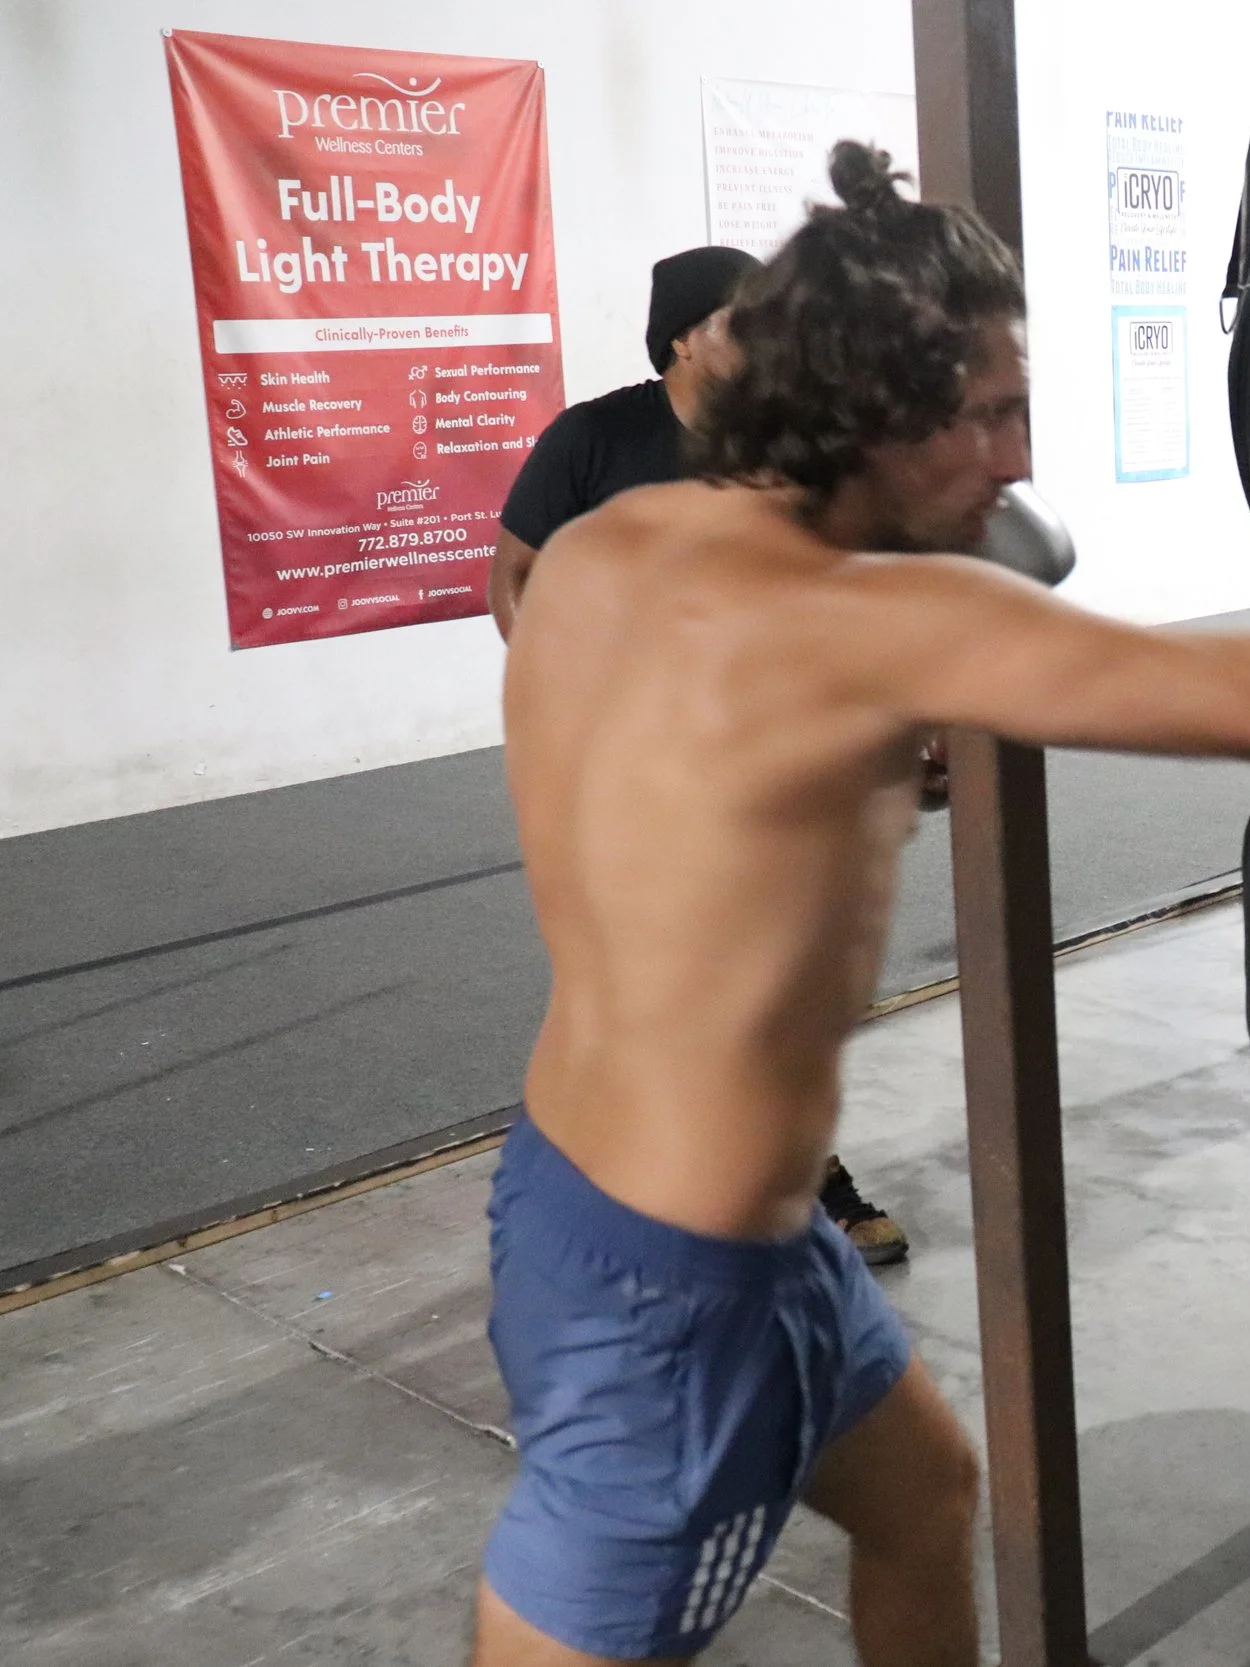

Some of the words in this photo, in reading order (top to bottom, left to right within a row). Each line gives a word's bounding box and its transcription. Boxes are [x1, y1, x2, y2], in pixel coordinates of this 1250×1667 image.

[272, 77, 466, 138] premier
[314, 136, 372, 154] Wellness
[375, 140, 423, 156] Centers
[1124, 173, 1173, 211] iCRYO
[278, 175, 480, 233] Full-Body
[236, 237, 348, 293] Light
[361, 237, 528, 291] Therapy
[1110, 244, 1141, 272] PAIN
[1145, 245, 1187, 273] RELIEF
[315, 327, 421, 343] Clinically-Proven
[425, 325, 469, 339] Benefits
[1134, 325, 1169, 350] iCRYO
[260, 372, 288, 386] Skin
[291, 370, 330, 384] Health
[435, 364, 467, 378] Sexual
[471, 363, 540, 376] Performance
[262, 399, 305, 413] Muscle
[309, 399, 362, 411] Recovery
[435, 390, 460, 405] Body
[464, 388, 527, 402] Contouring
[264, 426, 313, 440] Athletic
[317, 423, 390, 437] Performance
[435, 415, 473, 429] Mental
[477, 413, 515, 427] Clarity
[437, 440, 498, 454] Relaxation
[502, 436, 523, 450] and
[526, 435, 538, 448] Sl
[266, 454, 299, 468] Joint
[303, 452, 330, 465] Pain
[376, 481, 440, 510] premier
[247, 531, 283, 542] 10050
[287, 529, 304, 539] SW
[308, 525, 360, 537] Innovation
[363, 522, 381, 532] Way
[390, 518, 414, 528] Suite
[417, 515, 440, 525] #201
[451, 513, 472, 522] Port
[474, 511, 487, 519] St.
[358, 528, 467, 552] 772.879.8700
[276, 545, 497, 581] www.premierwellnesscente
